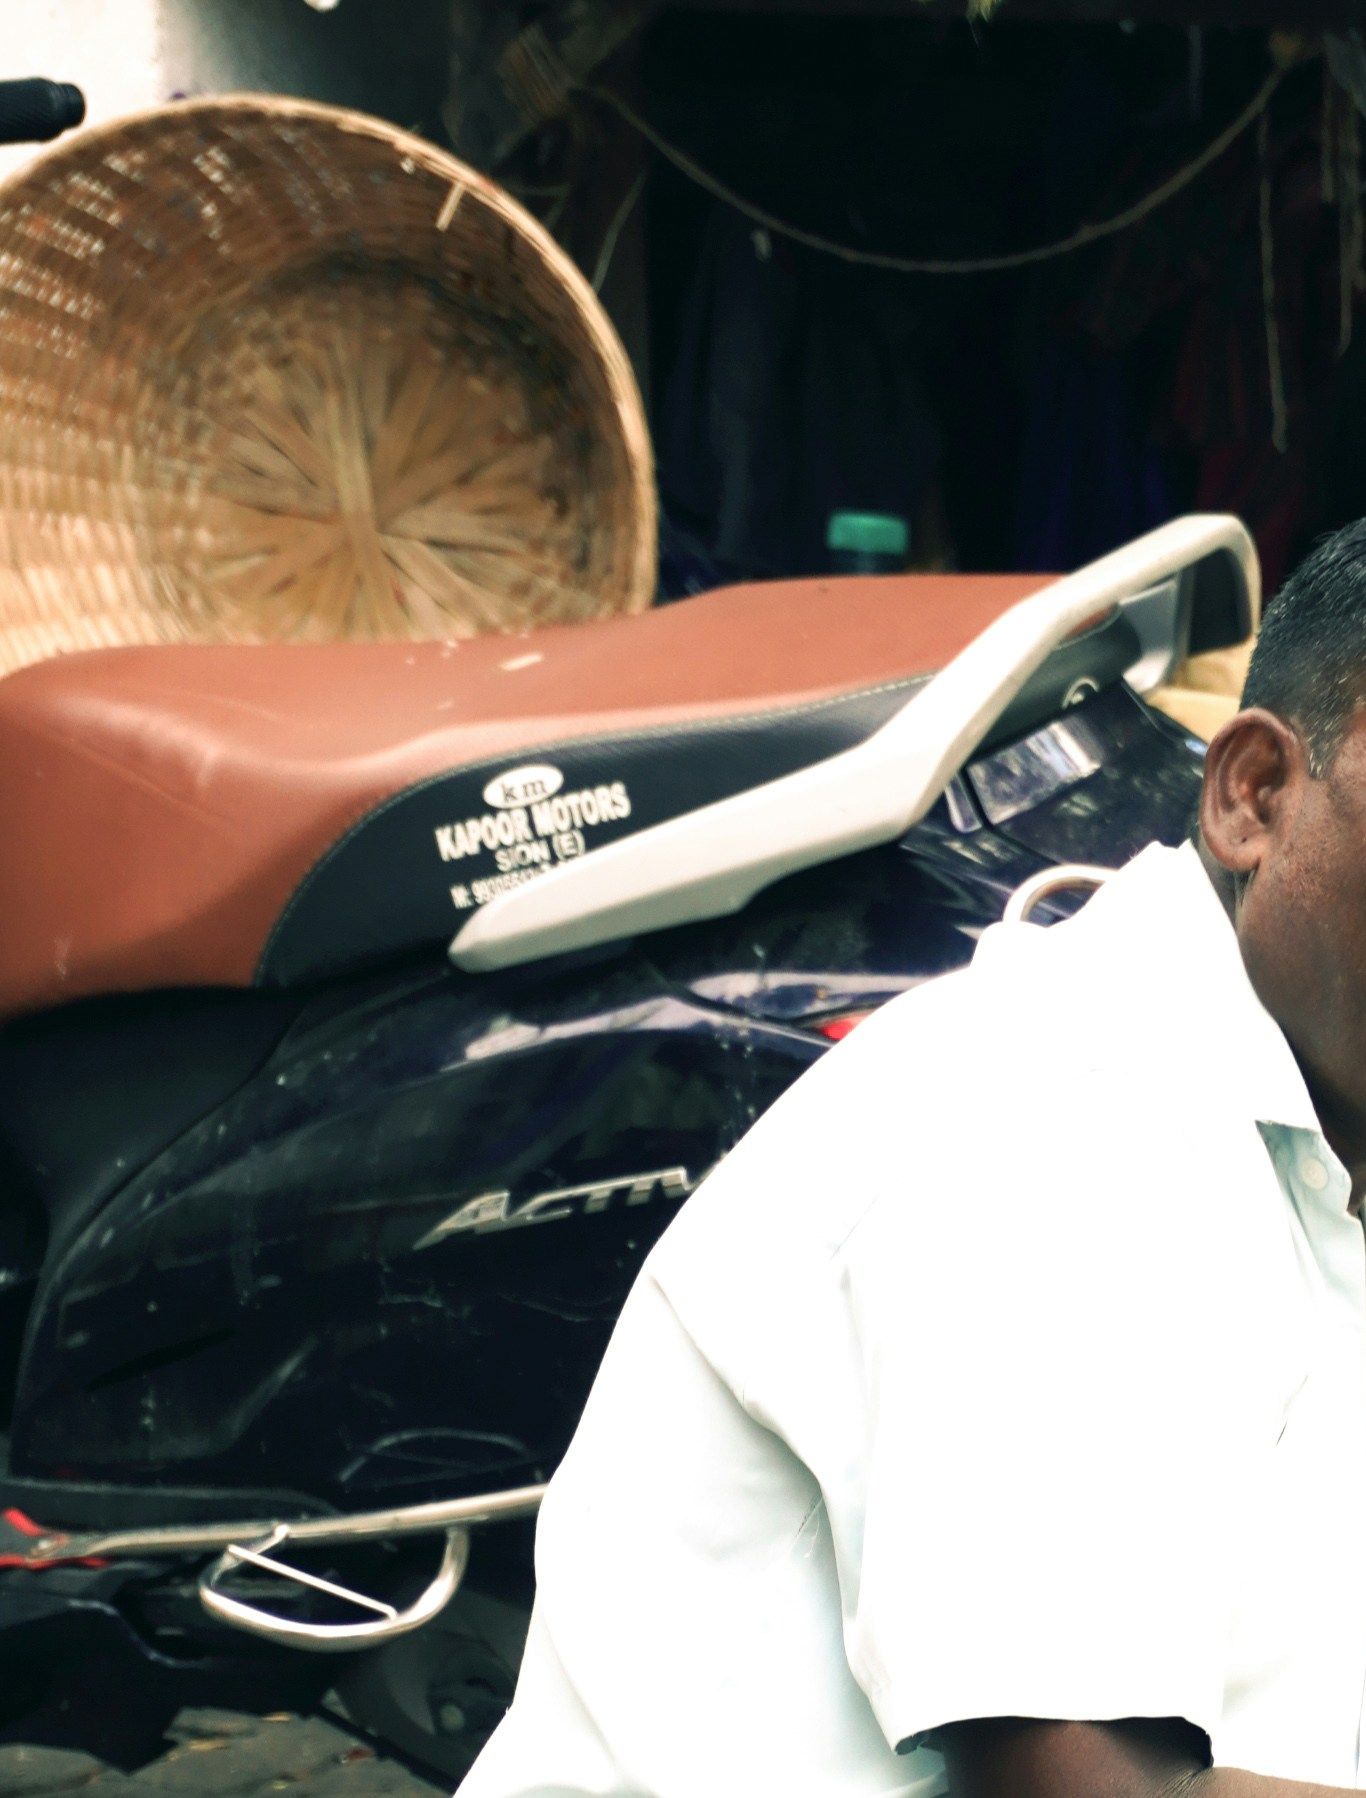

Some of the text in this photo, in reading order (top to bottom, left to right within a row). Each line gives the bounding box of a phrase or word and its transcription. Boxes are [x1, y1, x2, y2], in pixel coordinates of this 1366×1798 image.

[435, 780, 632, 862] KAPOOR MOTORS
[494, 840, 552, 872] SION
